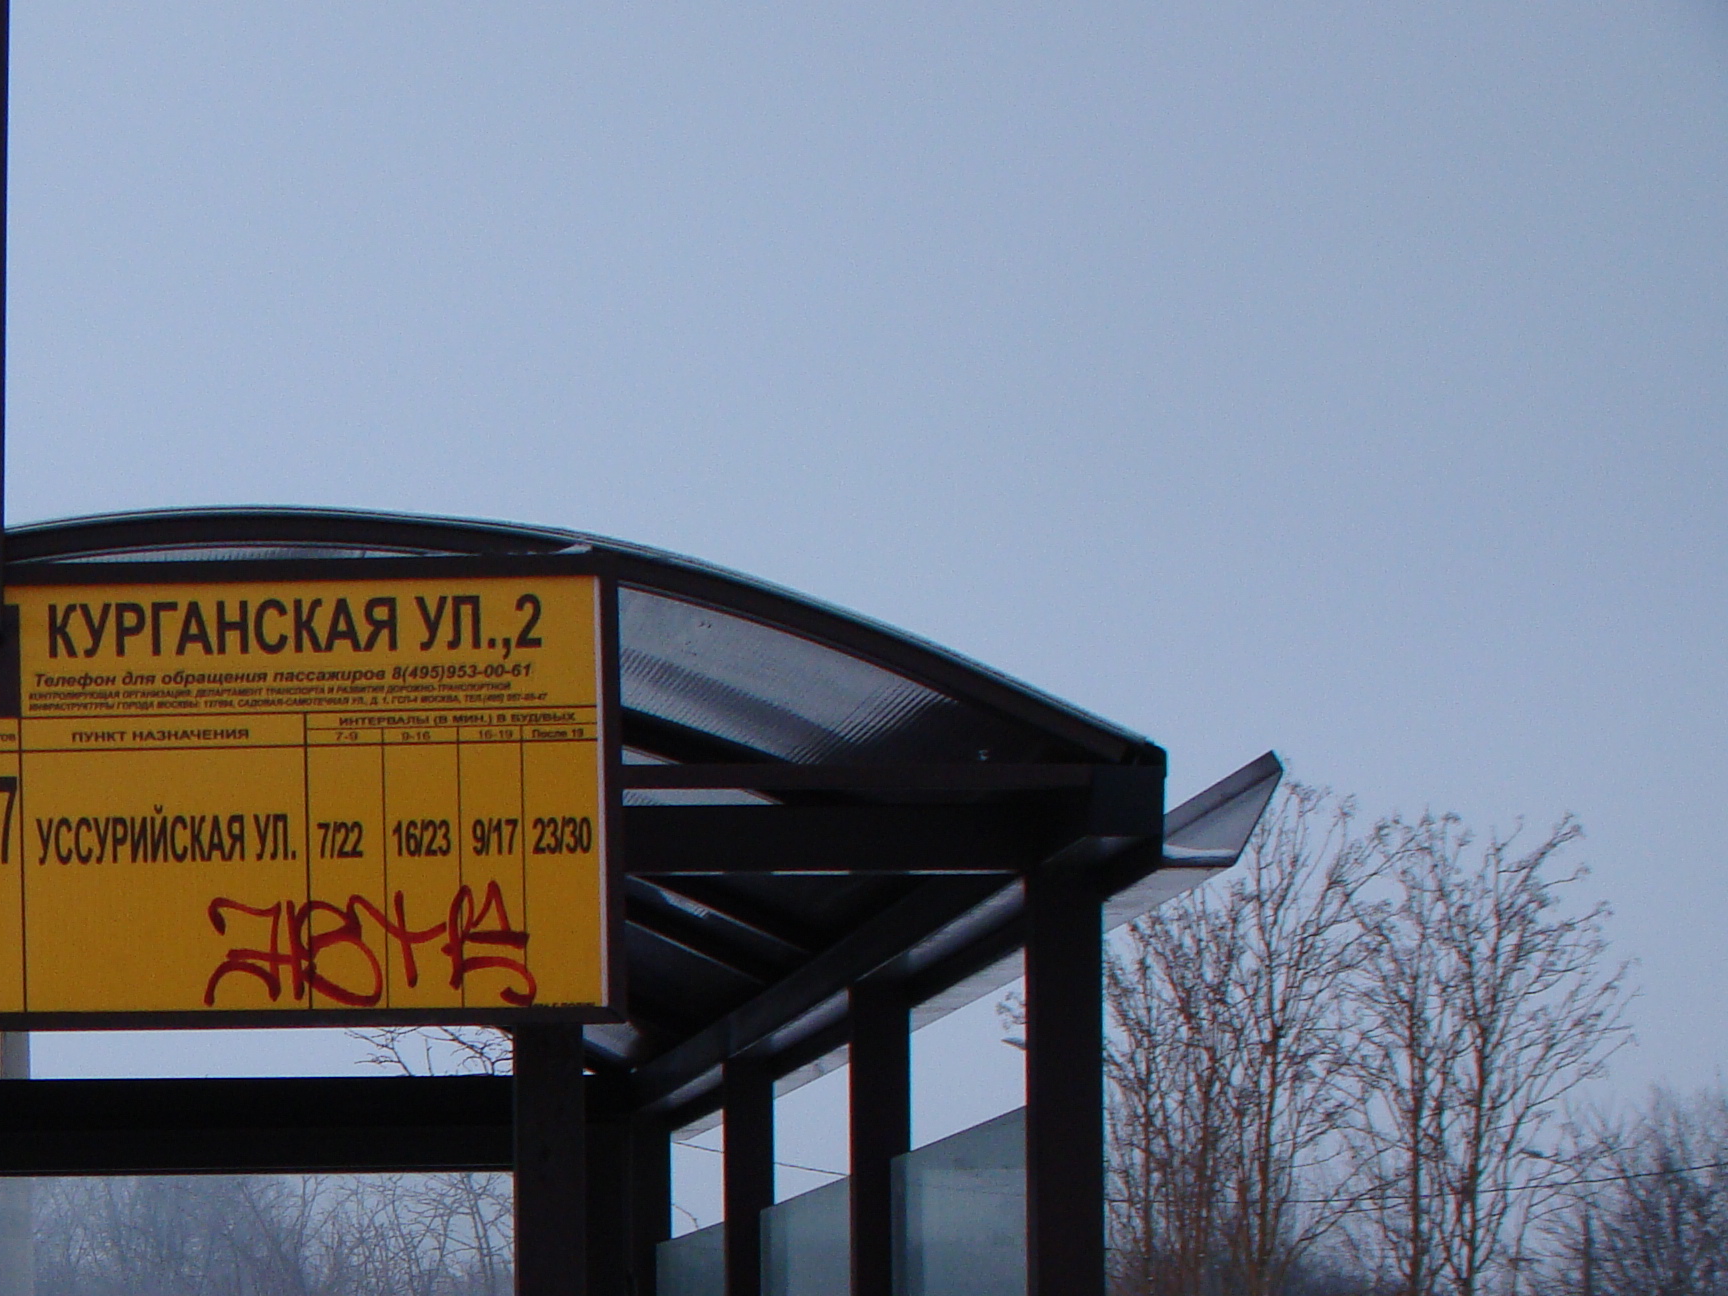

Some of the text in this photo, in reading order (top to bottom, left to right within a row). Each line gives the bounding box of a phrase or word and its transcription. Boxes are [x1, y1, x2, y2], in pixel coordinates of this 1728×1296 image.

[47, 593, 542, 661] КУРГАНСКАЯ УЛ.,2
[34, 663, 532, 690] Телефон для обращения пассажиров 8(495)953-00-61
[71, 728, 249, 743] ПУНКТ НАЗНАЧЕНИЯ
[339, 715, 429, 727] ИНТЕРВАЛЫ
[496, 713, 506, 723] В
[532, 729, 568, 739] После
[35, 804, 297, 865] УССУРИЙСКАЯ УЛ.
[317, 820, 363, 859] 7/22
[392, 819, 451, 858] 16/23
[472, 817, 518, 856] 9/17
[532, 816, 592, 854] 23/30
